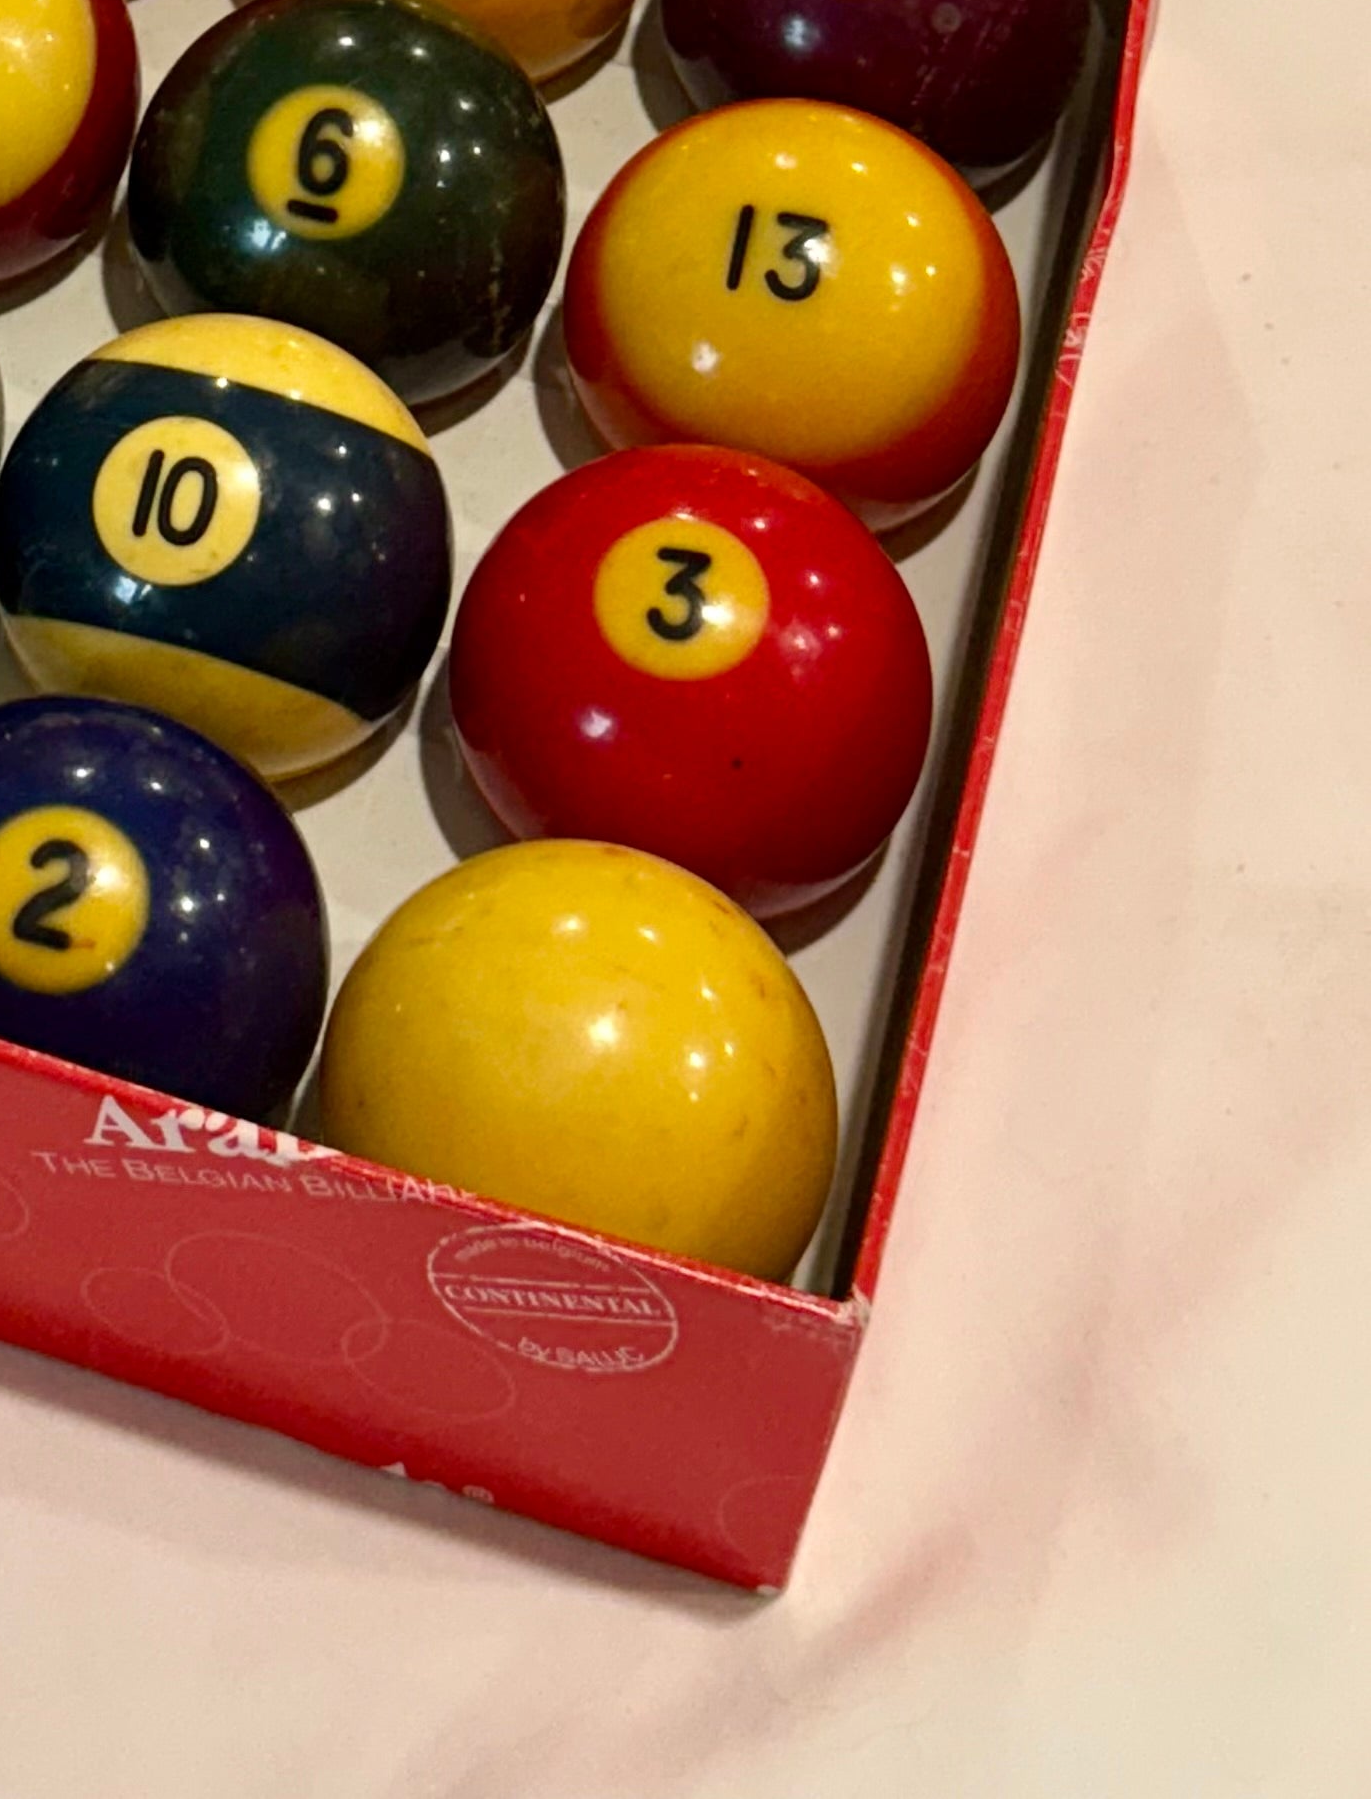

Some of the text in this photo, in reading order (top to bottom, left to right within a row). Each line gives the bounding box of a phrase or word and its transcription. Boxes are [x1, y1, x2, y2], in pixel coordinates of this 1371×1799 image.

[285, 107, 353, 227] 6
[725, 204, 831, 302] 13
[131, 449, 218, 547] 10
[646, 547, 712, 642] 3
[11, 839, 87, 953] 2
[30, 1151, 117, 1178] THE
[122, 1157, 293, 1194] BELGIAN
[444, 1284, 662, 1317] CONTINENTAL
